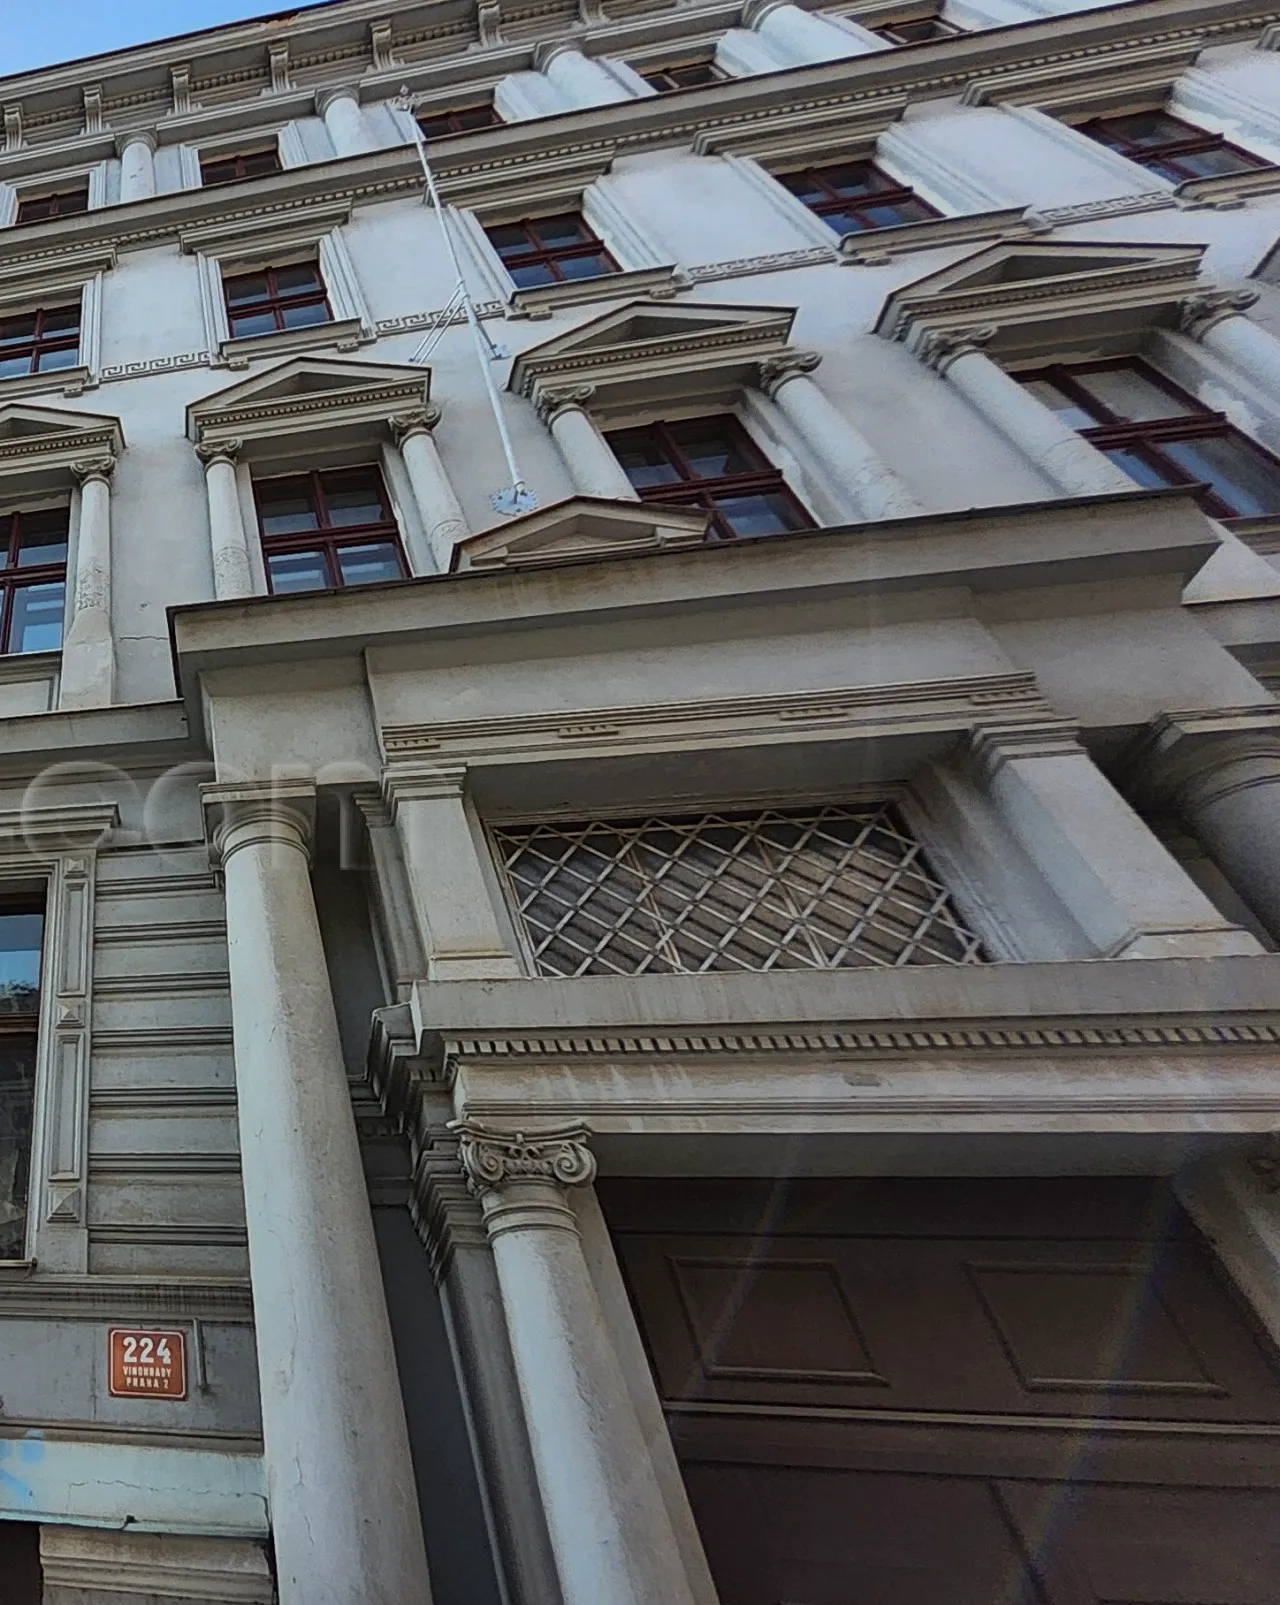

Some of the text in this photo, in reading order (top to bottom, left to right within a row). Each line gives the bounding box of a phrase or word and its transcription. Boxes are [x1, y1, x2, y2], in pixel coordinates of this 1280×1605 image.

[123, 1336, 171, 1364] 224
[122, 1366, 172, 1378] VINOHRADY
[126, 1377, 169, 1389] PRAHA 2
